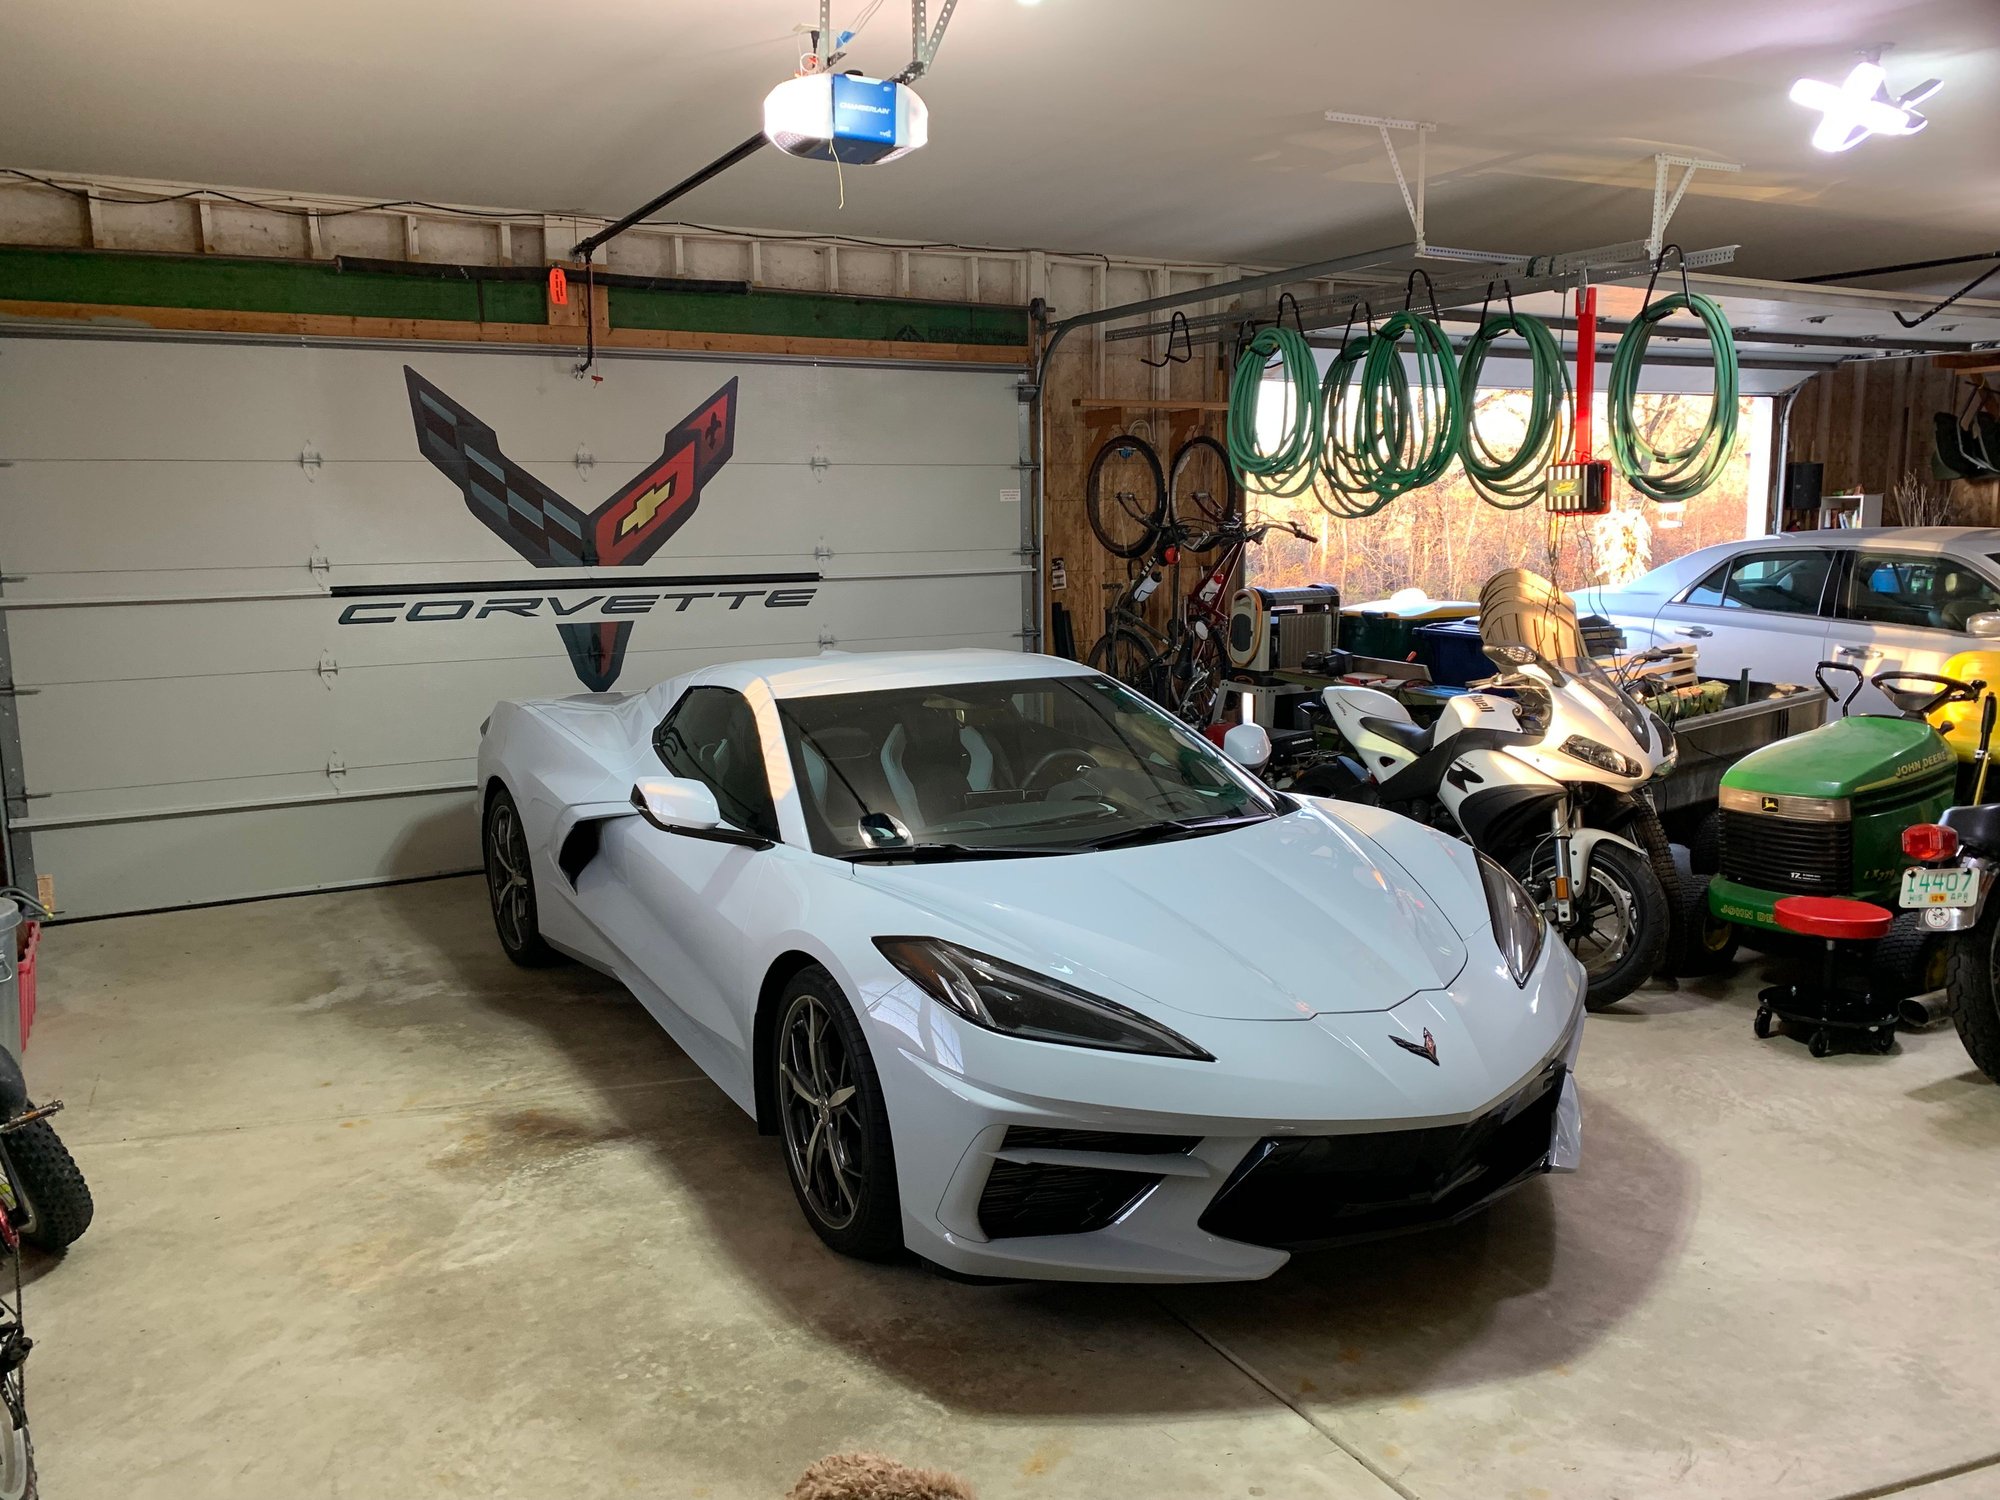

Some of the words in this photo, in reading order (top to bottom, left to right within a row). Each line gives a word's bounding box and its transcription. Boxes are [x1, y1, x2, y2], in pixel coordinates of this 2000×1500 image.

[839, 101, 890, 115] CHAMBERLAIN
[338, 588, 818, 625] CORVETTE
[1896, 761, 1922, 778] JOHN
[1922, 751, 1948, 770] DEERE
[1950, 892, 1969, 900] APR
[1720, 904, 1754, 919] JOHN
